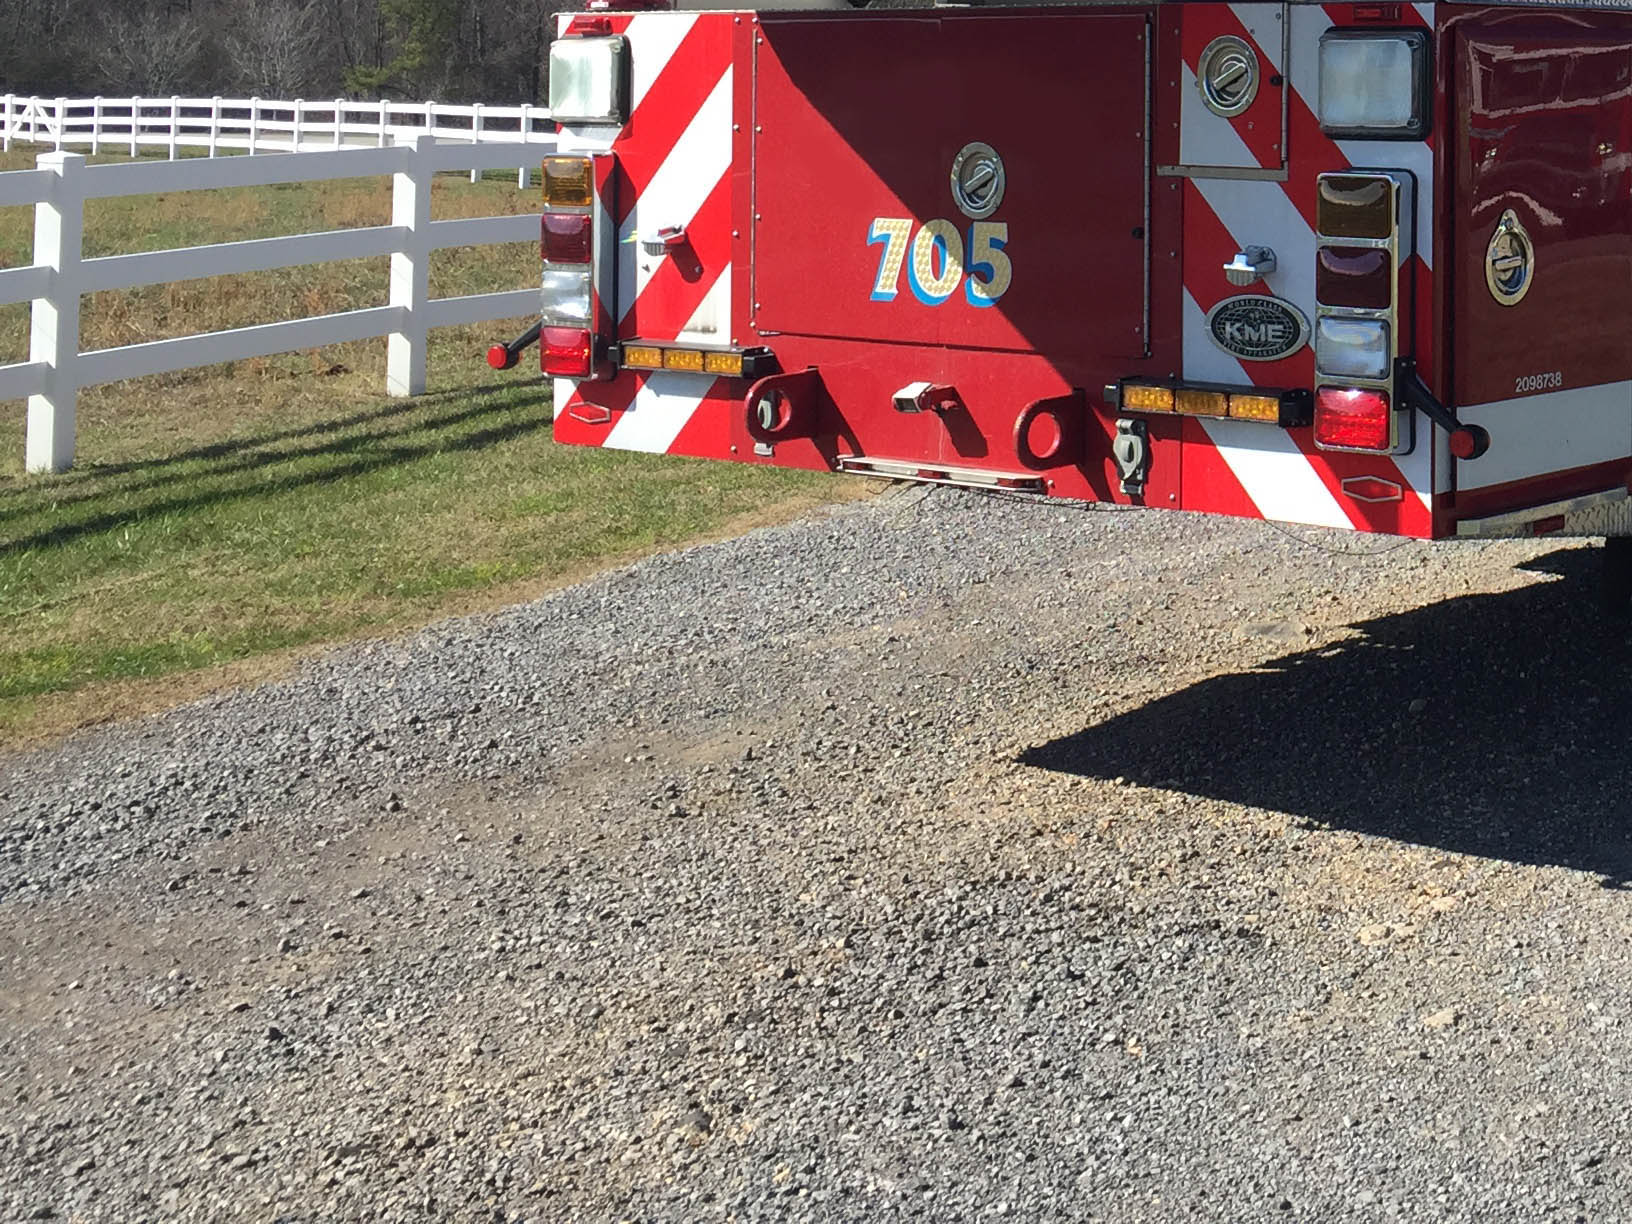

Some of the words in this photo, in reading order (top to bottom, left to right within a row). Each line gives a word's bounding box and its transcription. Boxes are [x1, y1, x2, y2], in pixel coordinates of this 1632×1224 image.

[866, 217, 1012, 308] 705
[1224, 320, 1284, 343] KME
[1515, 371, 1562, 393] 2098738
